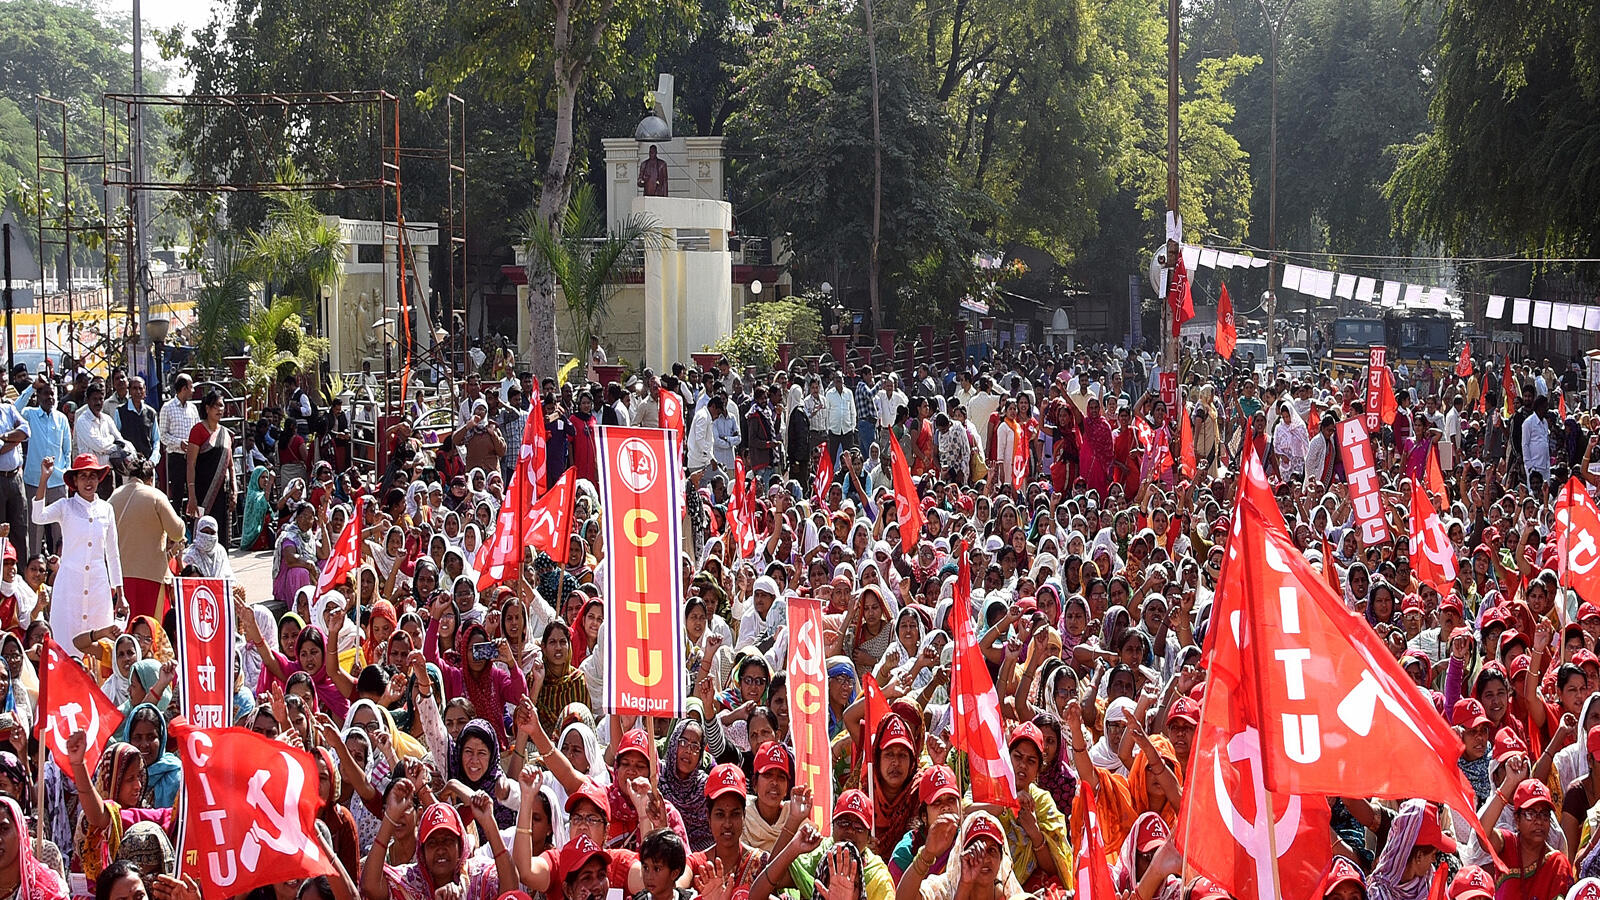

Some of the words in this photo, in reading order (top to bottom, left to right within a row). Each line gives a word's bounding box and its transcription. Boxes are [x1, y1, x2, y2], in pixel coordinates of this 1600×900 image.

[1342, 420, 1386, 546] AITUC
[623, 508, 662, 687] CITU
[621, 693, 668, 713] Nagpur
[186, 731, 239, 887] CITU
